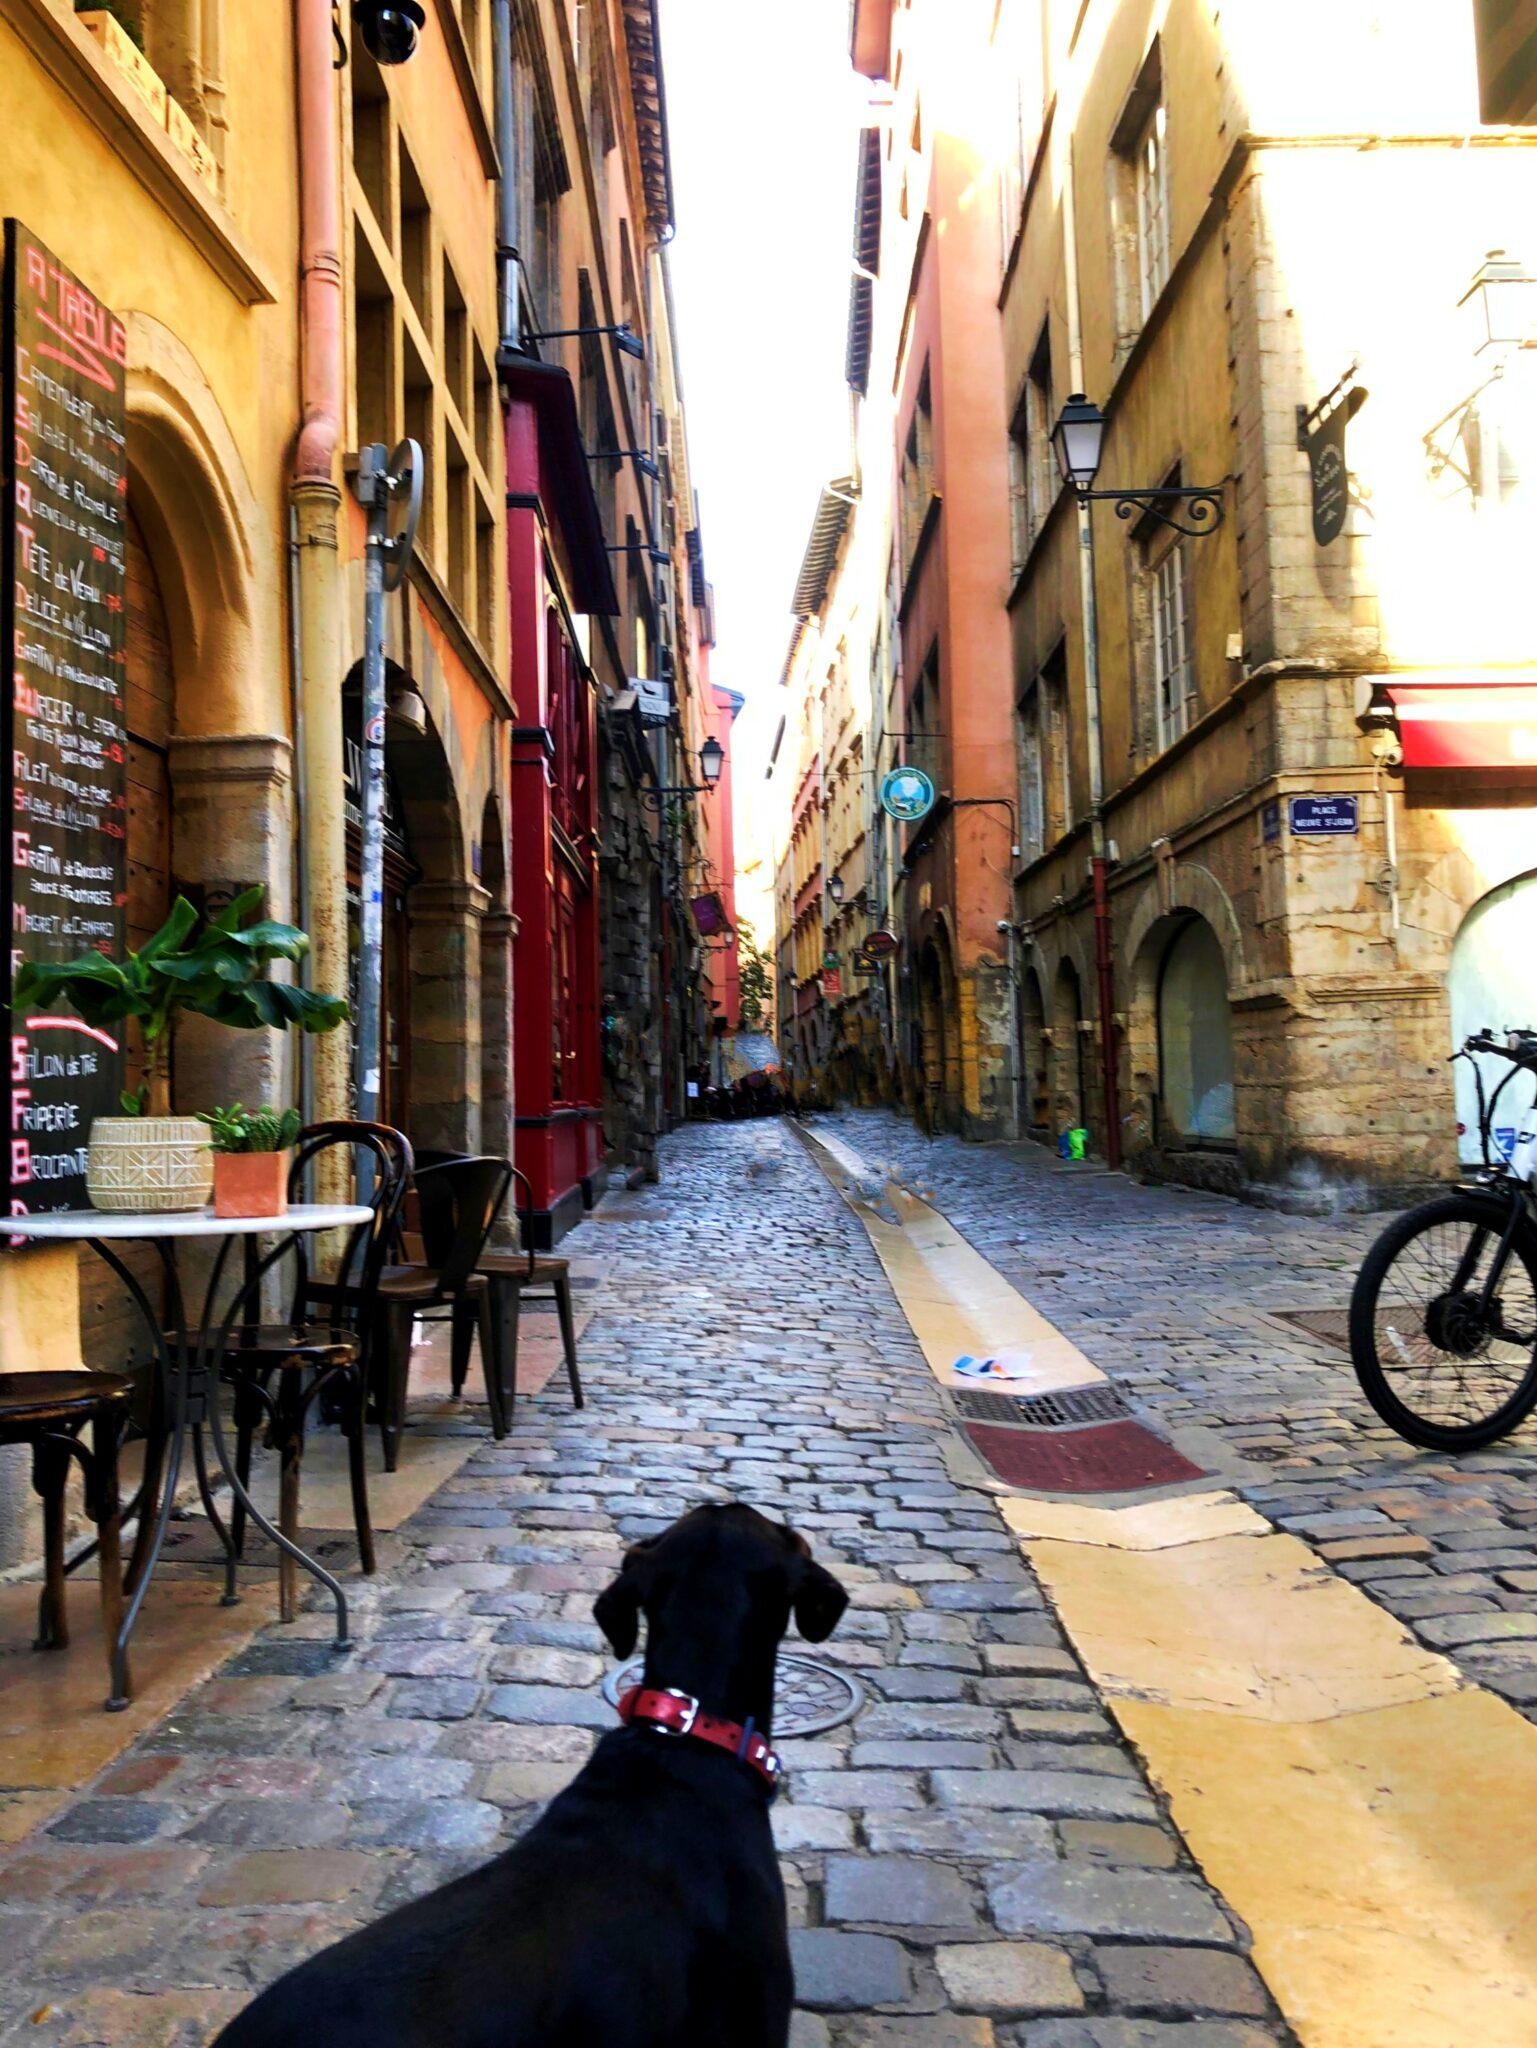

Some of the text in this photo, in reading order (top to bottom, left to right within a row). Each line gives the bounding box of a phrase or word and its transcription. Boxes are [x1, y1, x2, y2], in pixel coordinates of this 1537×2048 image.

[48, 263, 126, 367] TABLE
[1295, 818, 1323, 828] NEUVE
[1311, 806, 1338, 815] PLACE
[11, 1034, 65, 1081] SALON
